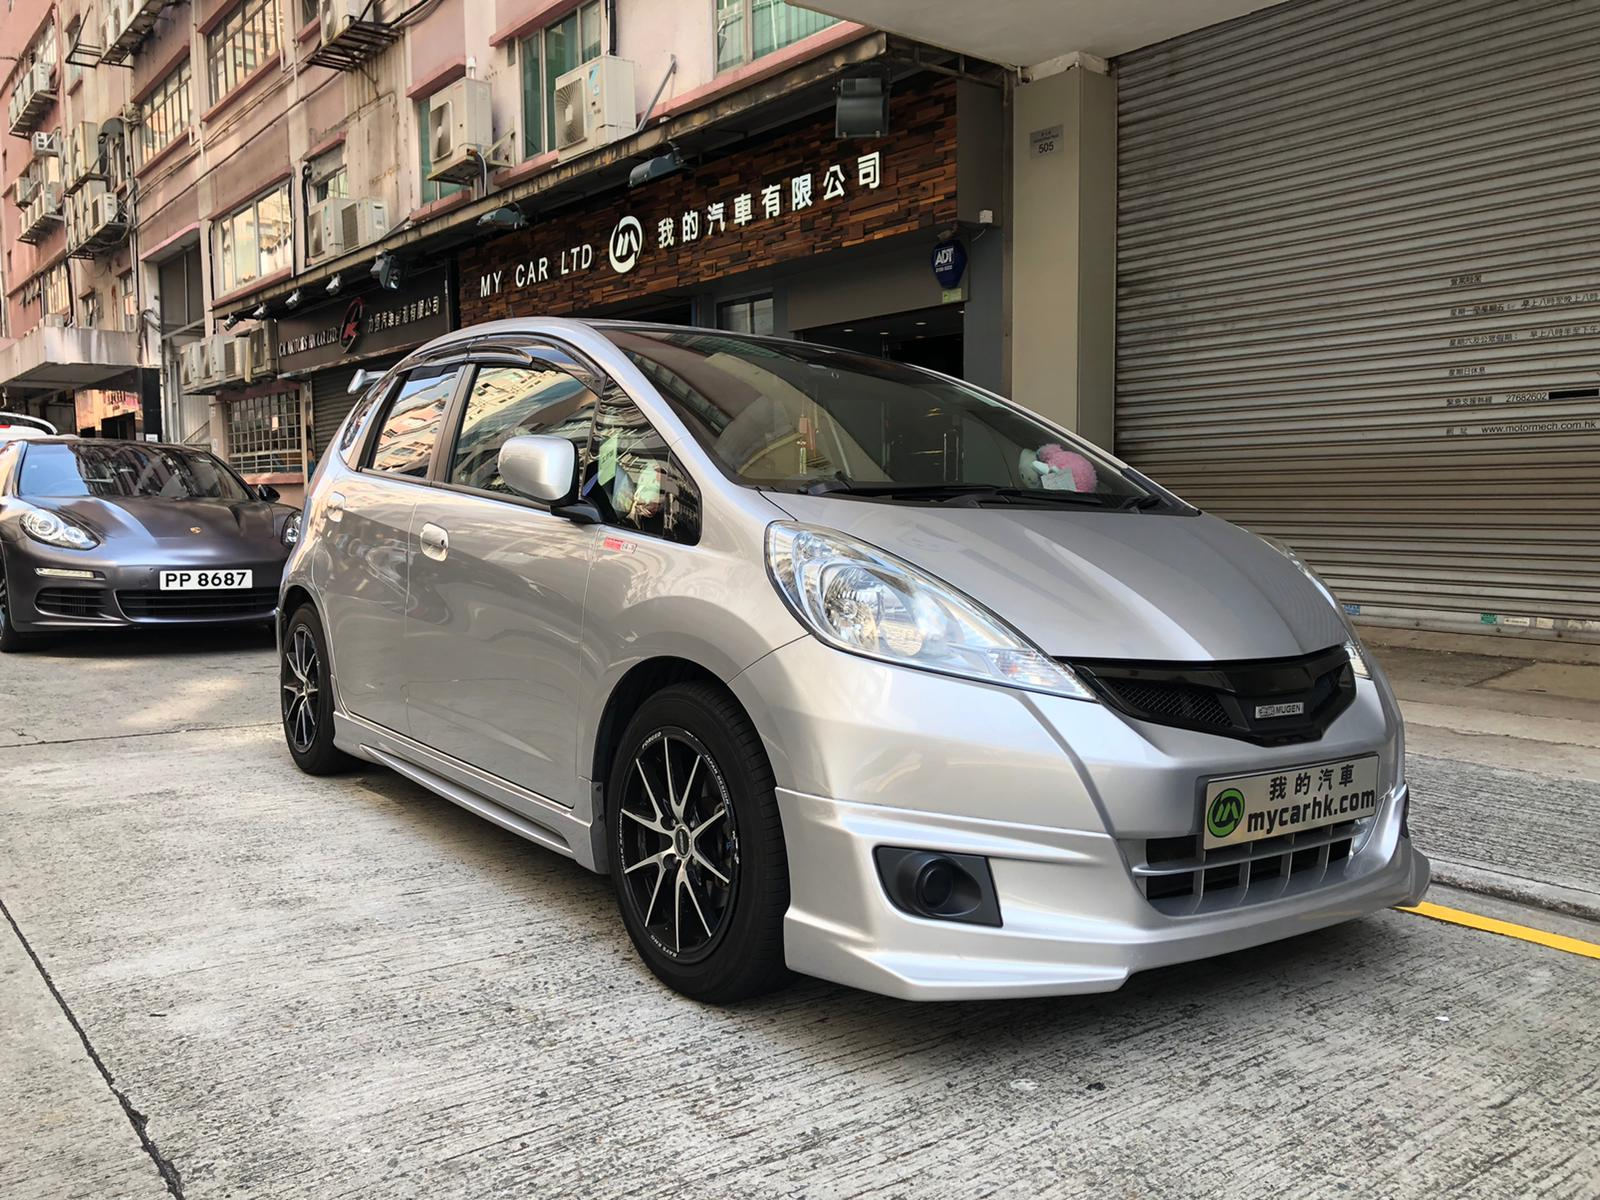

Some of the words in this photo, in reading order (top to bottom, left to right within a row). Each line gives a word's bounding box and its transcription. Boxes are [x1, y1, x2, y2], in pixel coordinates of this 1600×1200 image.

[1038, 141, 1054, 154] 505
[657, 151, 882, 249] 我的汽車有限公司
[934, 247, 954, 265] ADT
[480, 270, 502, 299] MY
[515, 257, 548, 289] CAR
[560, 244, 593, 276] LTD
[1505, 392, 1547, 403] 27682602
[1481, 420, 1597, 434] www.motormech.com.hk
[165, 573, 191, 587] PP
[197, 572, 247, 587] 8687
[1275, 703, 1301, 715] MUGEN
[1269, 764, 1354, 801] 我的汽車
[1247, 788, 1375, 835] mycarhk.com
